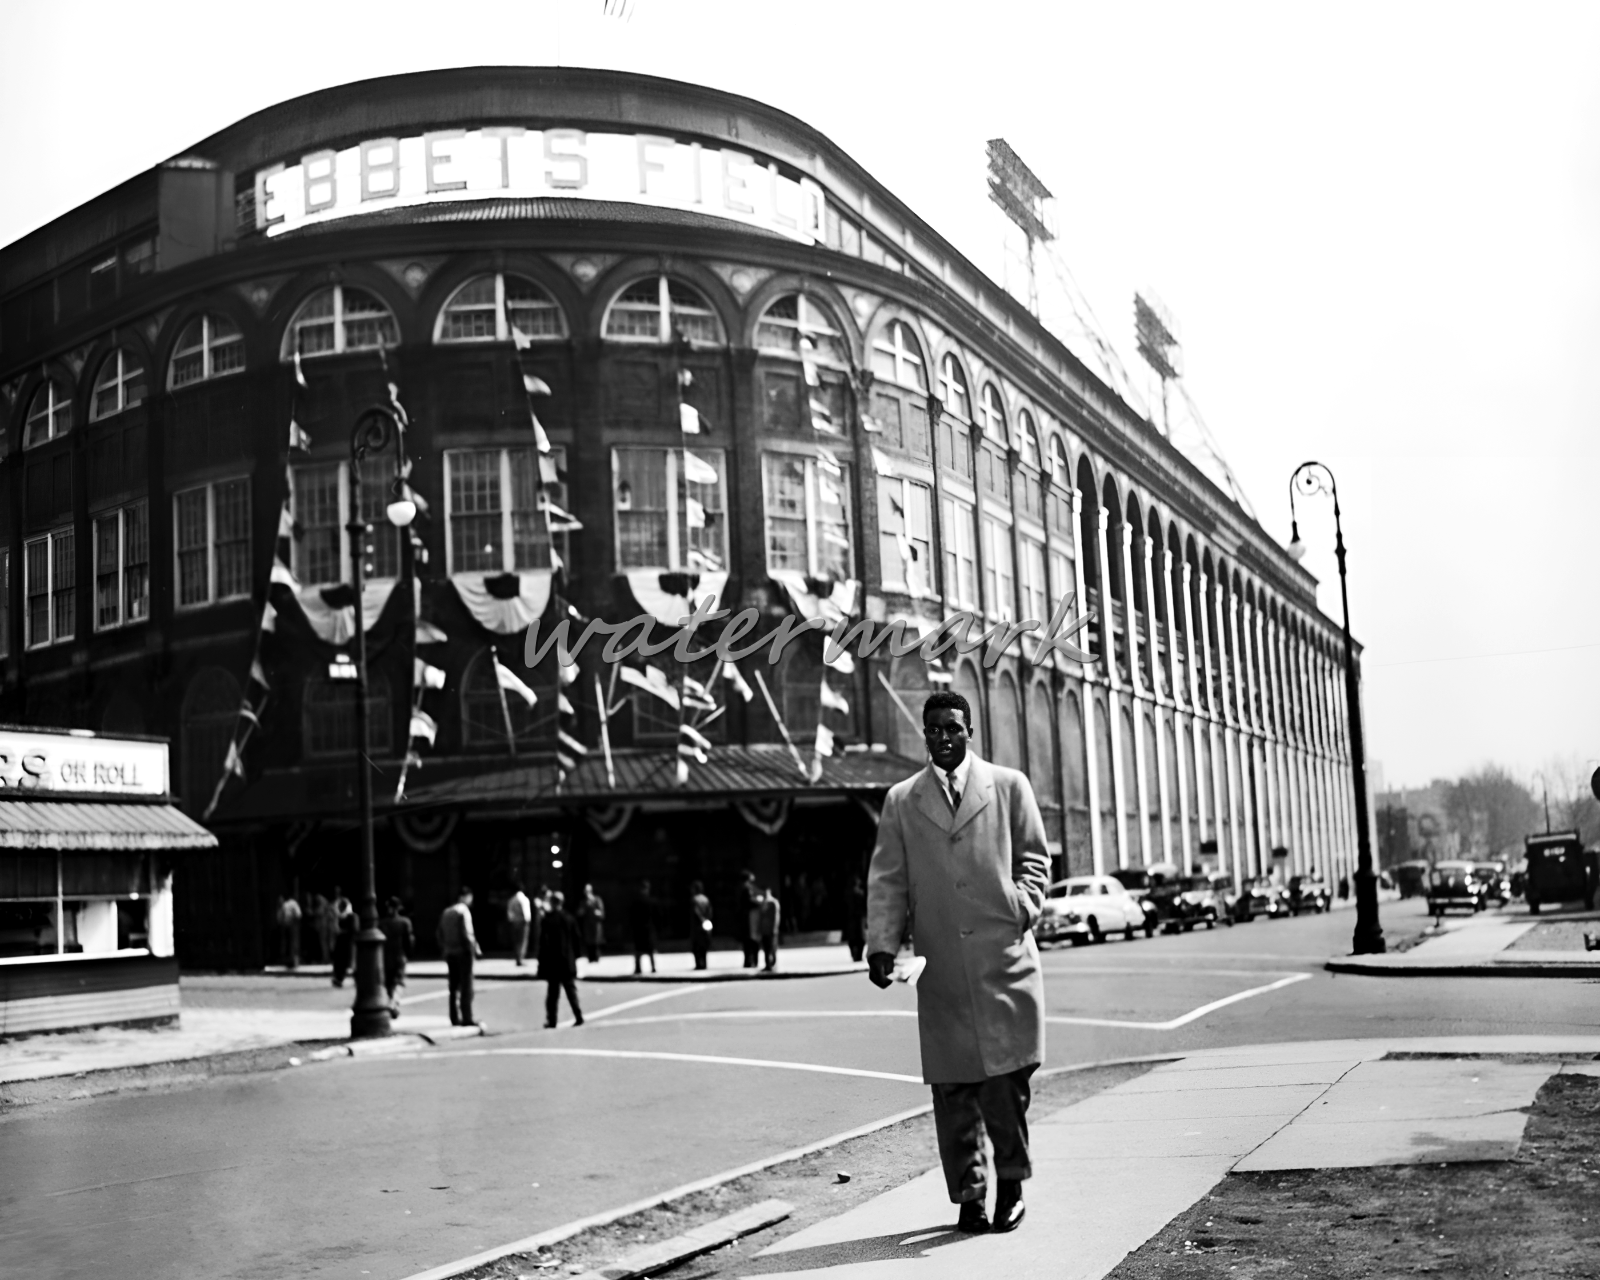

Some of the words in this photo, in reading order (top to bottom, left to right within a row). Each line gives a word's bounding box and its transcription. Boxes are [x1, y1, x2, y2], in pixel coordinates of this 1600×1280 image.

[254, 126, 588, 231] EBBETS
[635, 133, 826, 245] FIELD
[94, 761, 143, 786] ROLL
